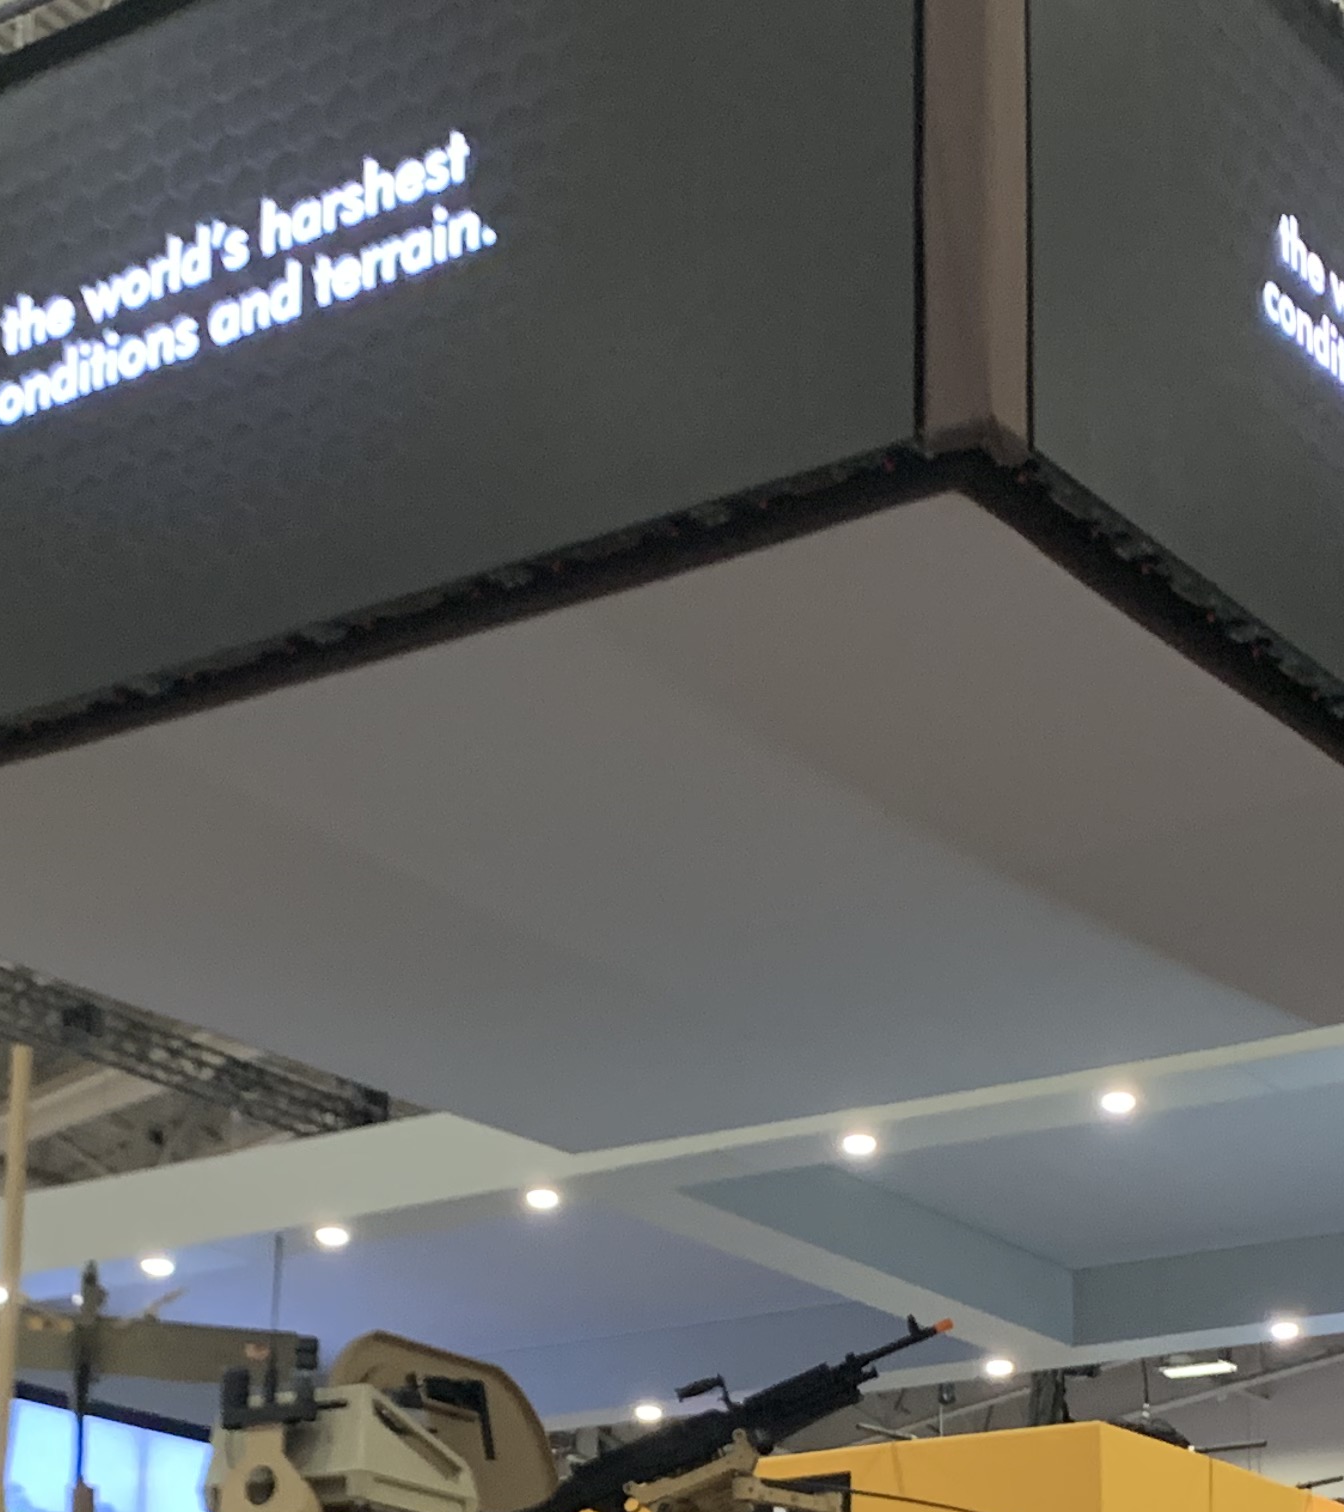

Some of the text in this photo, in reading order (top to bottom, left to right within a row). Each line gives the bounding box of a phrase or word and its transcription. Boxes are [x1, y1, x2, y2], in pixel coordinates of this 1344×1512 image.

[0, 130, 470, 355] the world's harshest
[207, 258, 303, 346] and
[312, 203, 498, 306] terrain.
[1277, 213, 1326, 295] the
